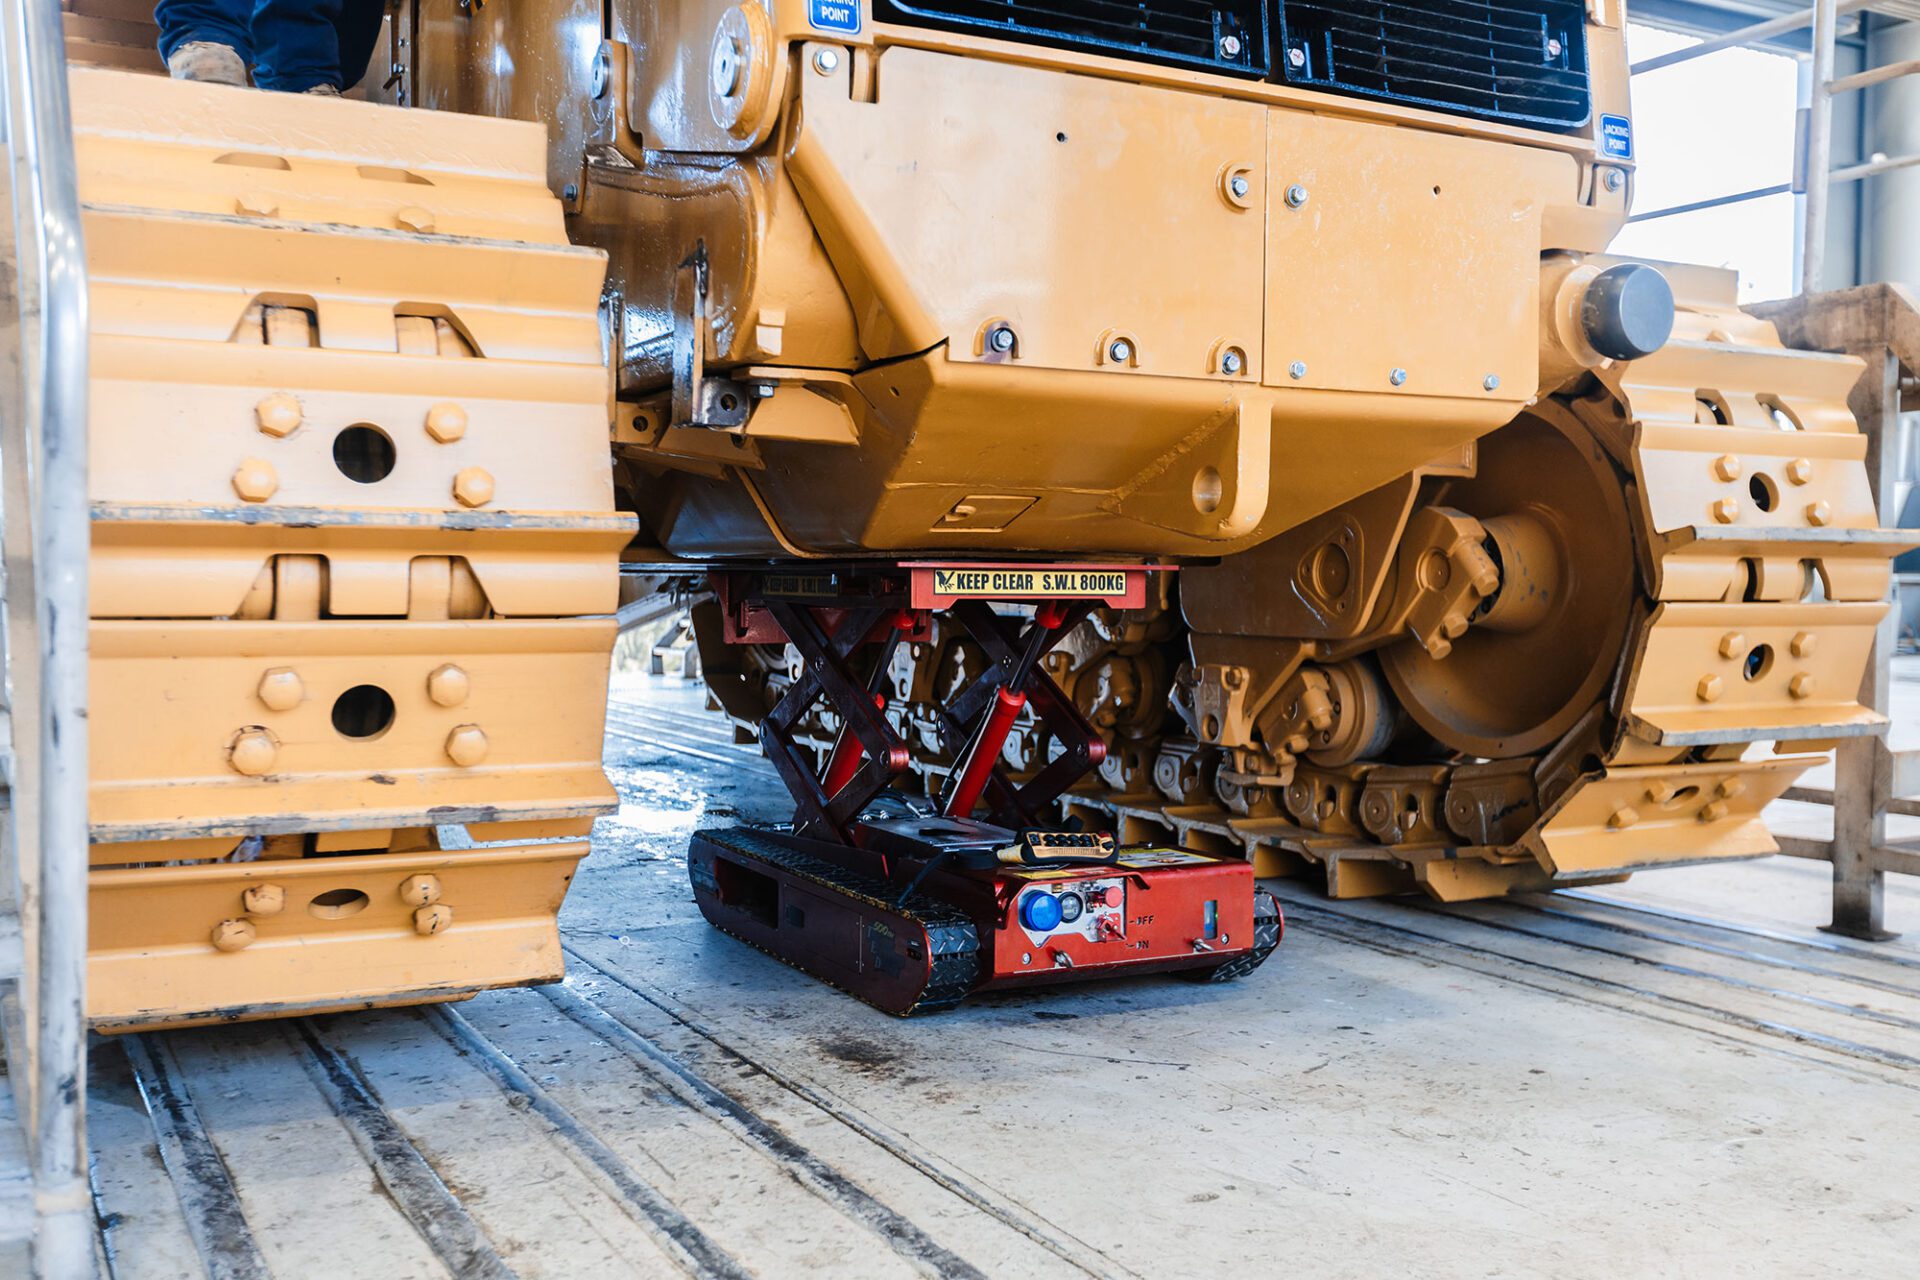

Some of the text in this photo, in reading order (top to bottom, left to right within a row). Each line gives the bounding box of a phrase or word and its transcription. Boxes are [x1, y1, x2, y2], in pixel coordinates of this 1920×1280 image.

[821, 6, 850, 23] POINT
[1605, 124, 1629, 137] JACKING
[1608, 138, 1626, 151] POINT
[956, 573, 1124, 591] KEEP CLEAR S.W.L 800KG
